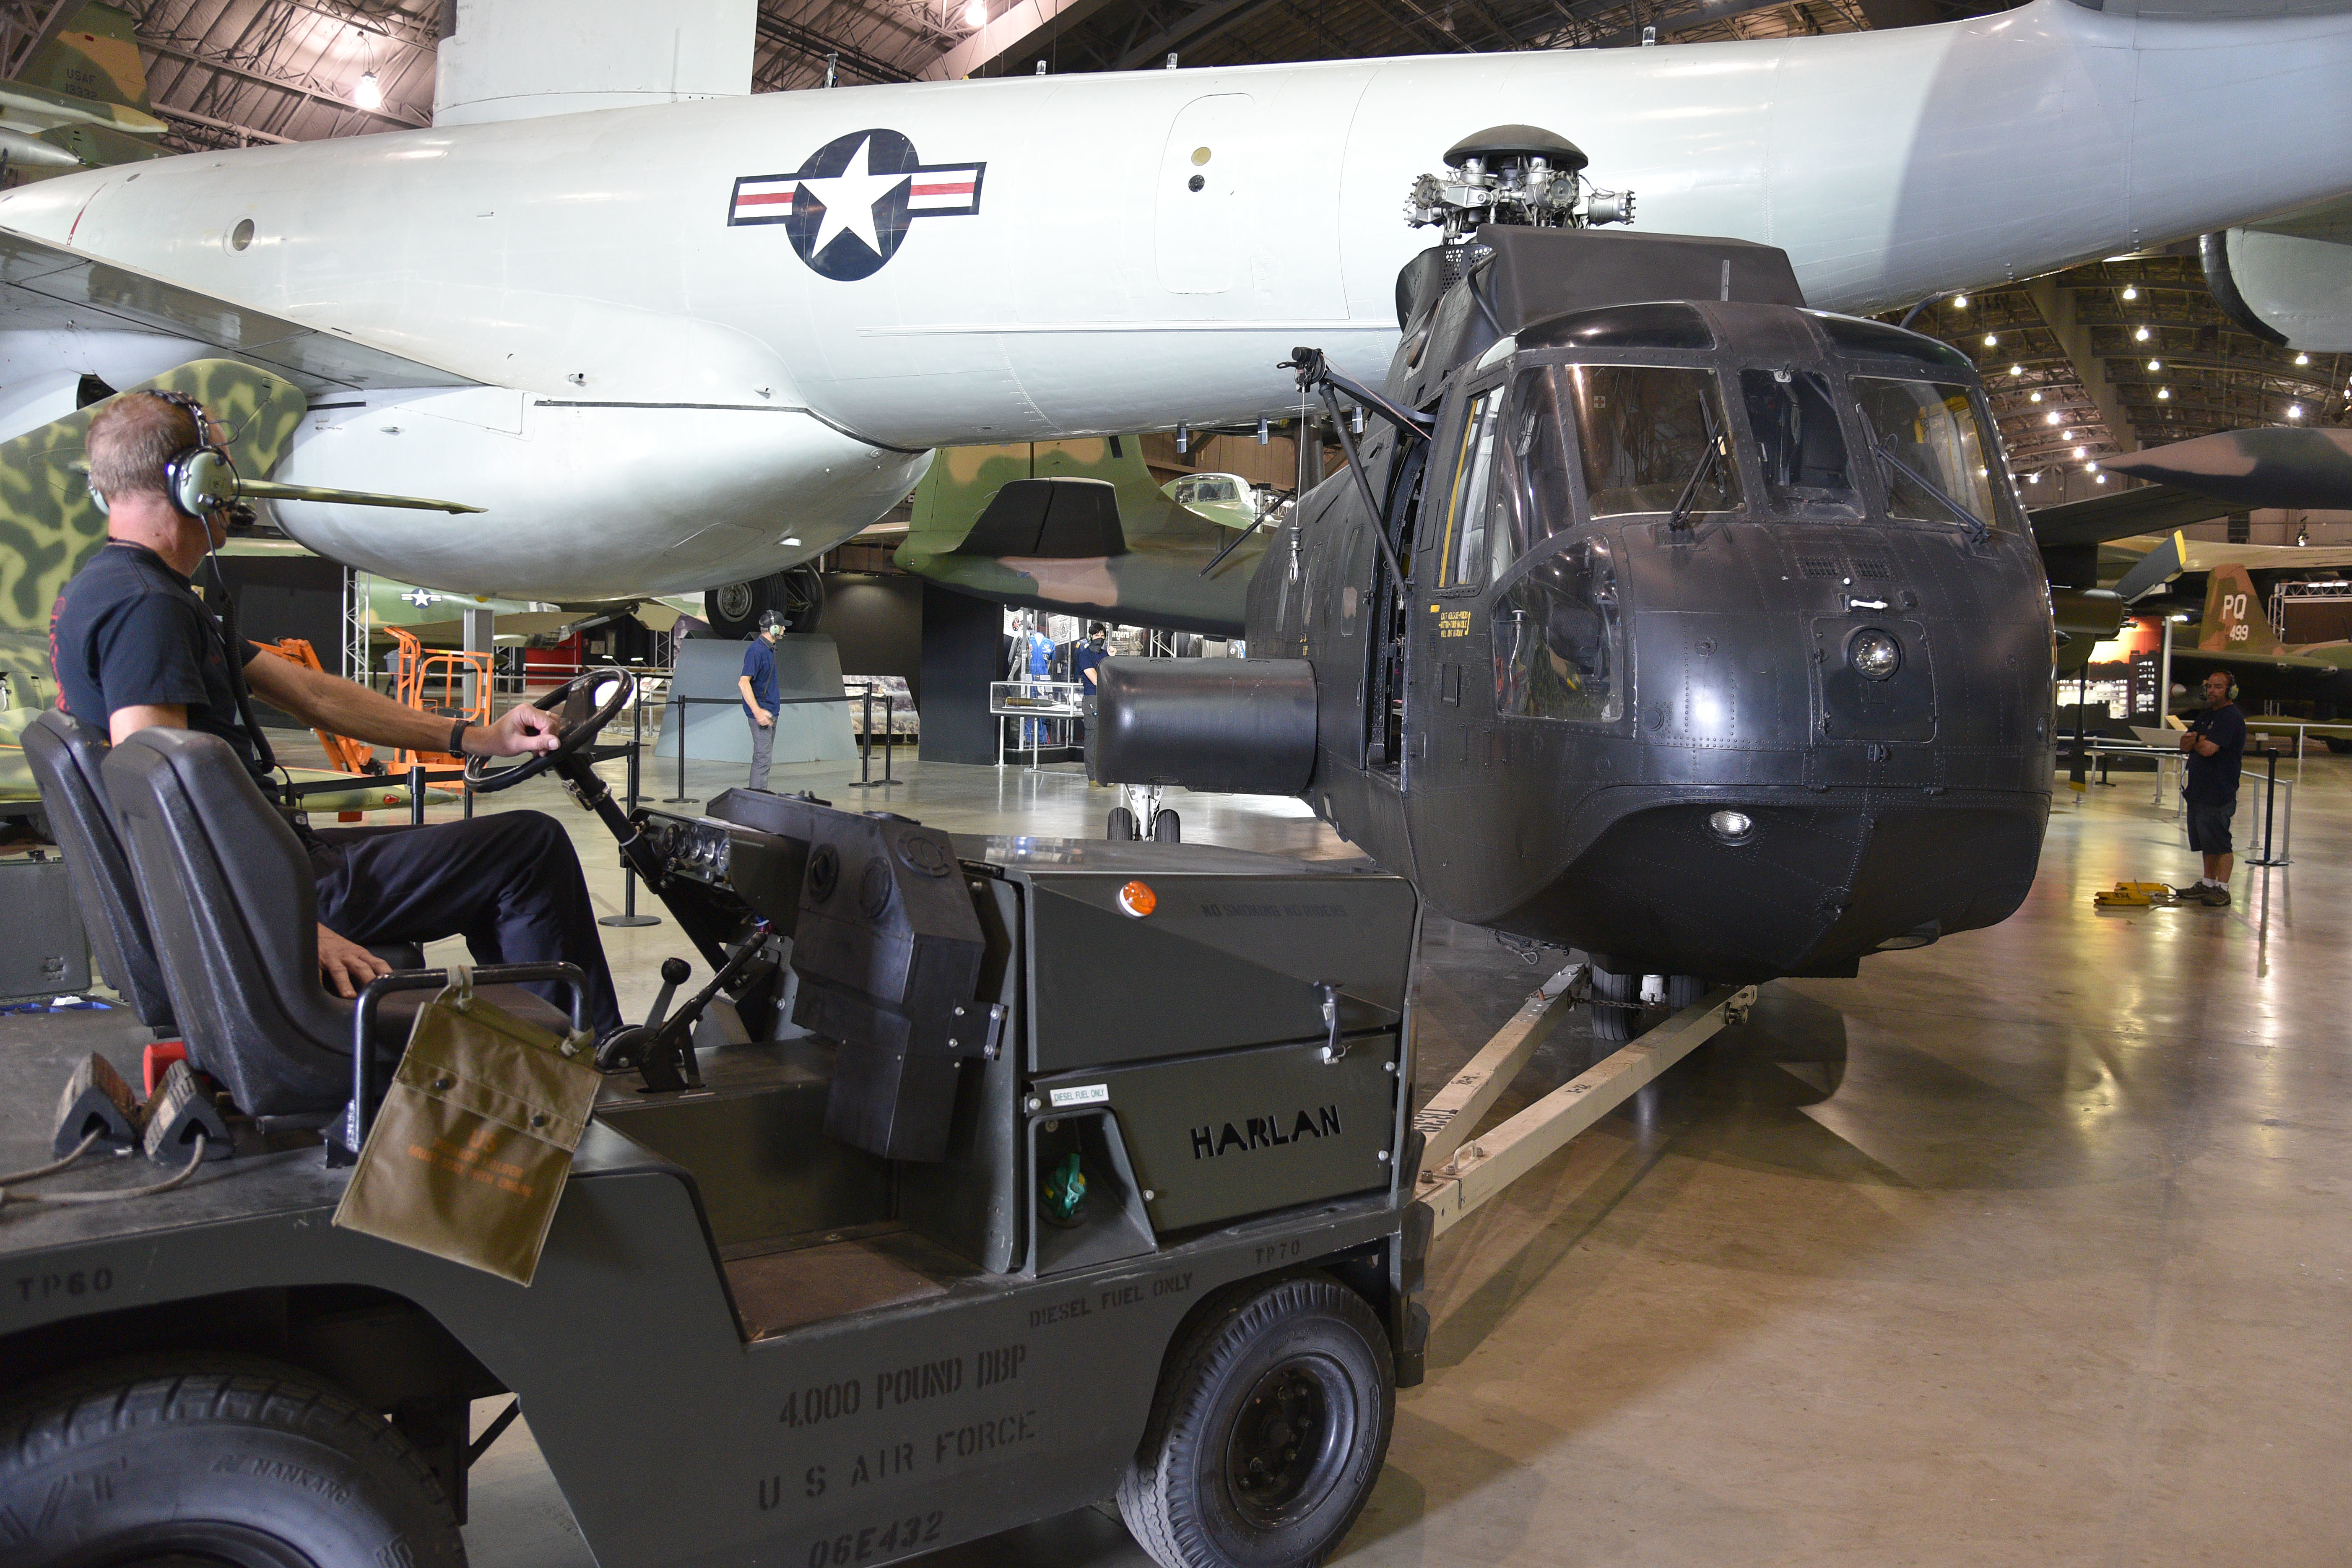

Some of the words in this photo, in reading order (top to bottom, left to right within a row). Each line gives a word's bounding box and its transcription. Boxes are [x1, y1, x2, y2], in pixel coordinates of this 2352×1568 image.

[67, 68, 96, 85] USAF
[2222, 594, 2247, 620] PQ
[2229, 624, 2249, 641] 499
[1054, 1092, 1074, 1102] DIESEL
[1075, 1090, 1089, 1099] FUEL
[1090, 1088, 1105, 1097] ONLY
[1190, 1105, 1341, 1159] HARLAN
[1255, 1239, 1300, 1265] TP70
[17, 1267, 112, 1301] TP60
[1030, 1298, 1089, 1328] DIESEL
[1101, 1286, 1144, 1310] FUEL
[1153, 1273, 1193, 1297] ONLY
[877, 1357, 963, 1410] POUND
[977, 1343, 1027, 1389] DBP
[758, 1475, 780, 1511] U
[805, 1465, 826, 1498] S
[851, 1442, 914, 1487] AIR
[936, 1409, 1037, 1463] FORCE
[251, 1457, 352, 1505] NANKANG
[807, 1511, 944, 1568] 06E432
